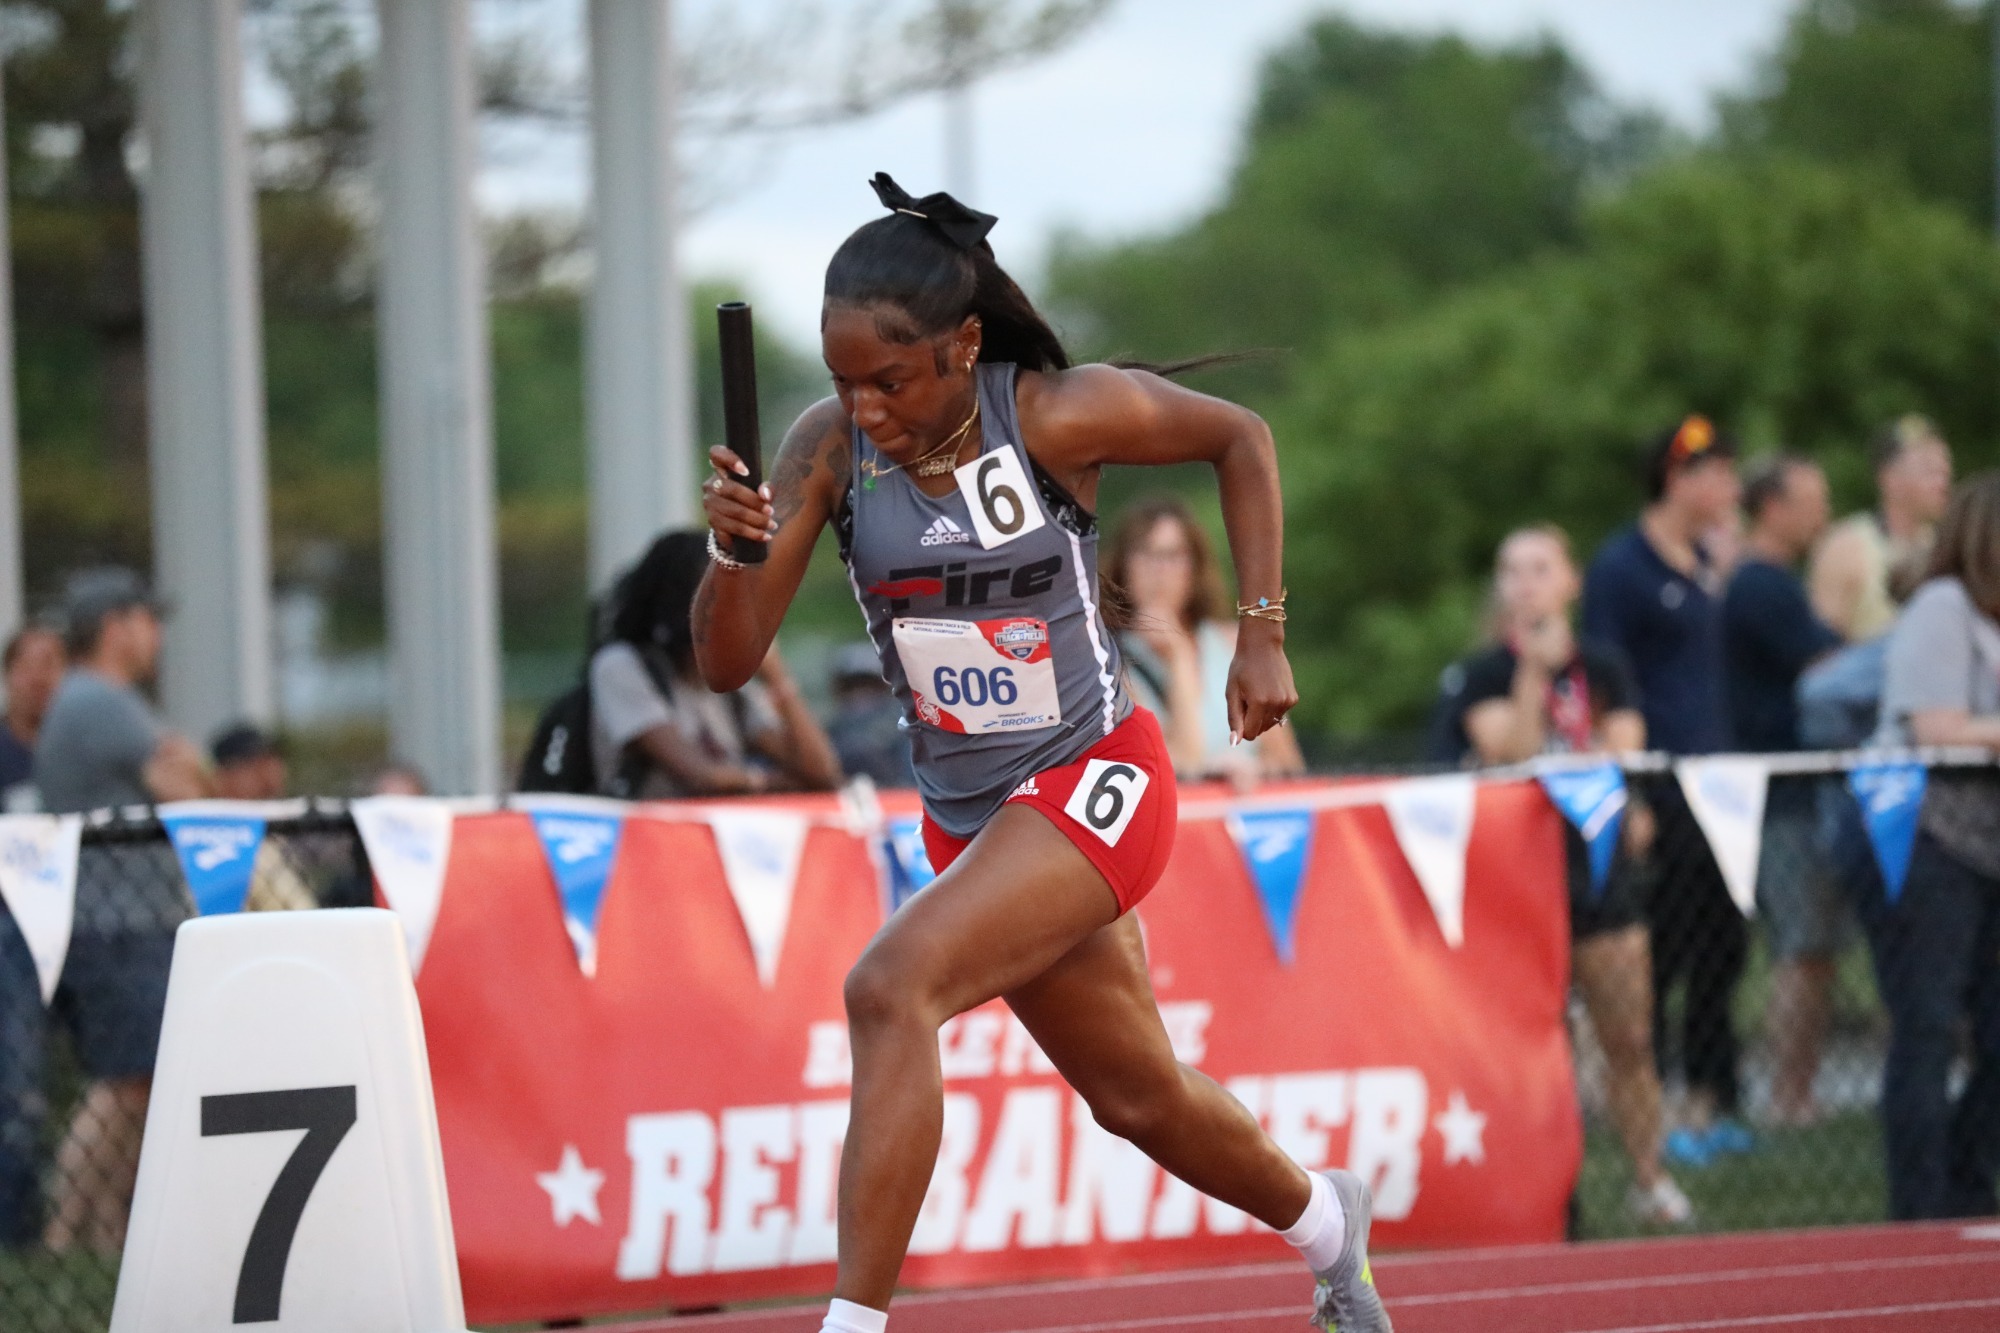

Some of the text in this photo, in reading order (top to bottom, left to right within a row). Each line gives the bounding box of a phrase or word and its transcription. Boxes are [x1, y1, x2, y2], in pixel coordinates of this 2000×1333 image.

[977, 456, 1025, 535] 6
[920, 532, 970, 547] adidas
[885, 555, 1062, 612] Fire
[933, 665, 1018, 706] 606
[1001, 715, 1044, 726] BROOKS
[1085, 764, 1137, 830] 6
[200, 1085, 357, 1324] 7
